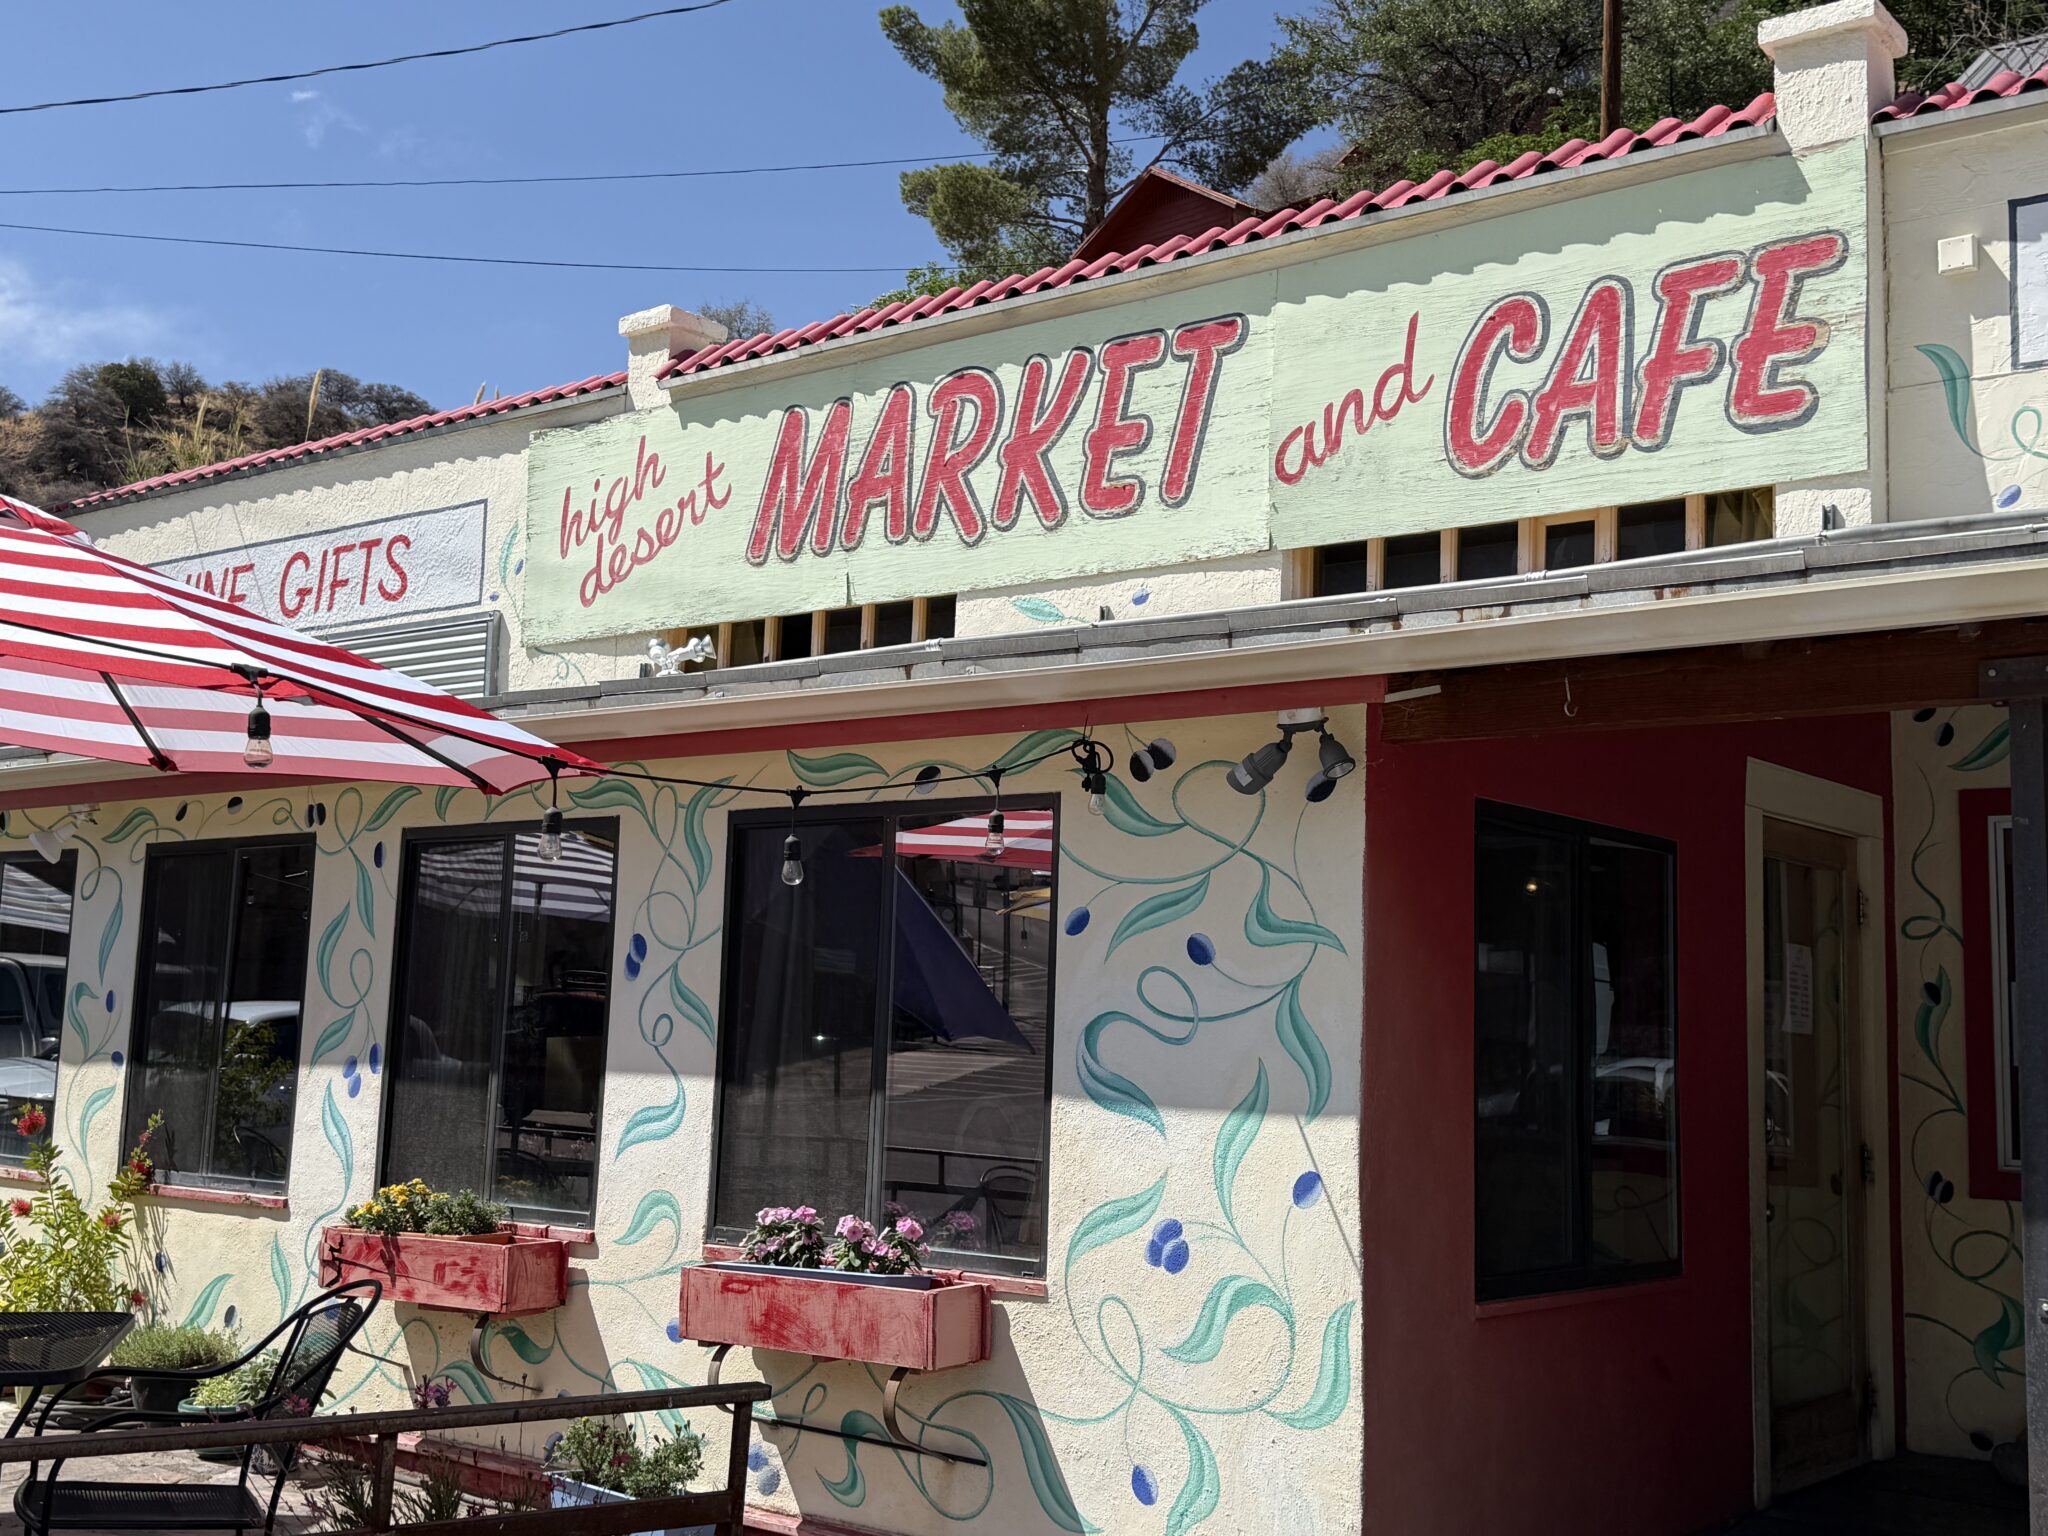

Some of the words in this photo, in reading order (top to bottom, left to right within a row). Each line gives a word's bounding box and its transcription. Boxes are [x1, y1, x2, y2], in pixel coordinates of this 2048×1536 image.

[745, 312, 1250, 567] MARKET
[1274, 311, 1436, 486] and
[1444, 229, 1849, 480] CAFE
[560, 435, 667, 559] high
[579, 451, 732, 608] desert
[185, 562, 256, 603] INE
[279, 534, 412, 619] GIFTS
